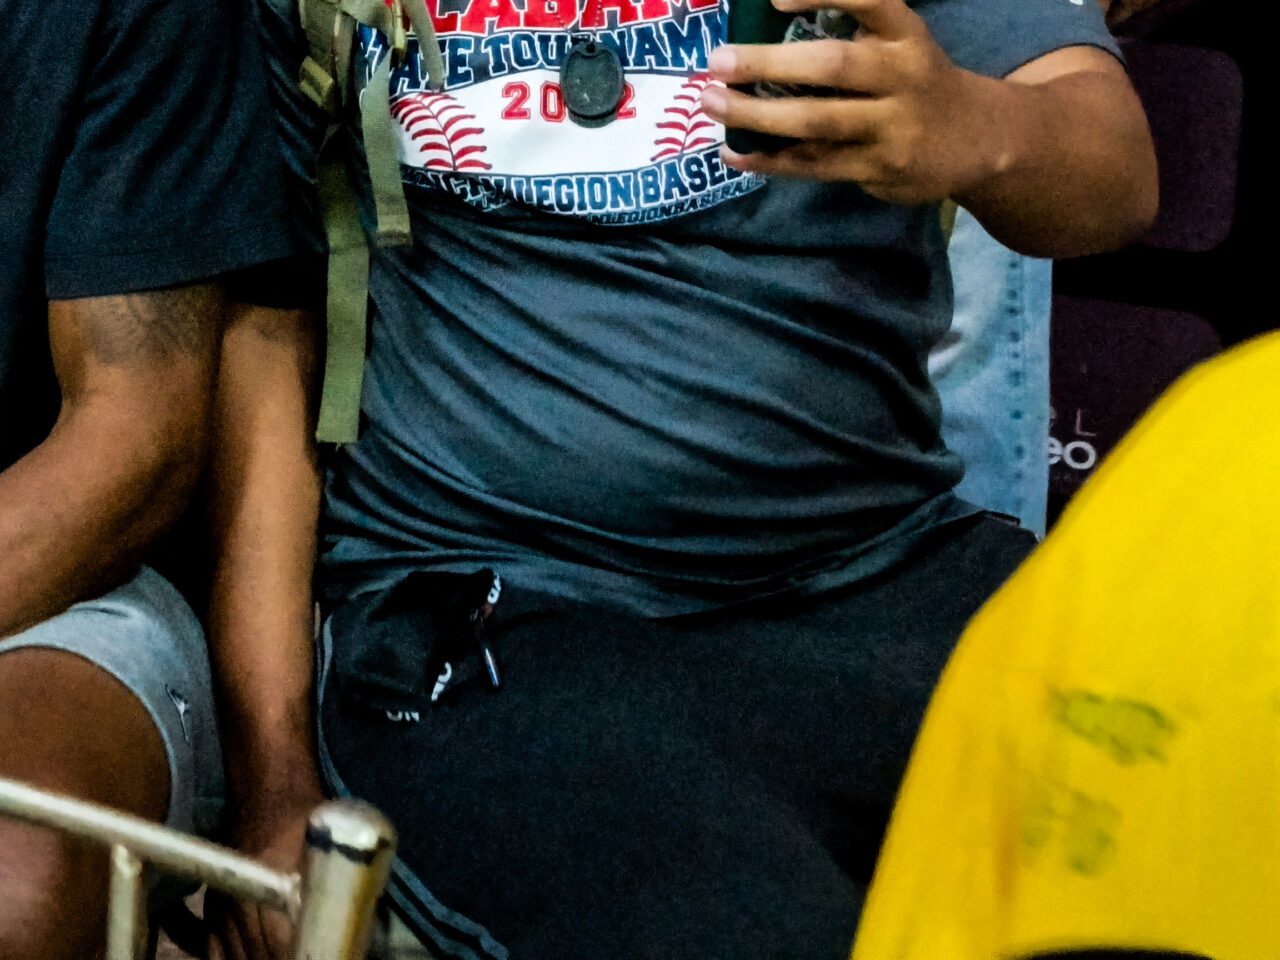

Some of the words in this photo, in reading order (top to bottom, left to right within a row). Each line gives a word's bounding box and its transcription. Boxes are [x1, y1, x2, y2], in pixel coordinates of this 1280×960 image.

[501, 81, 637, 123] 202
[513, 170, 635, 217] LEGION
[638, 145, 746, 210] BASE
